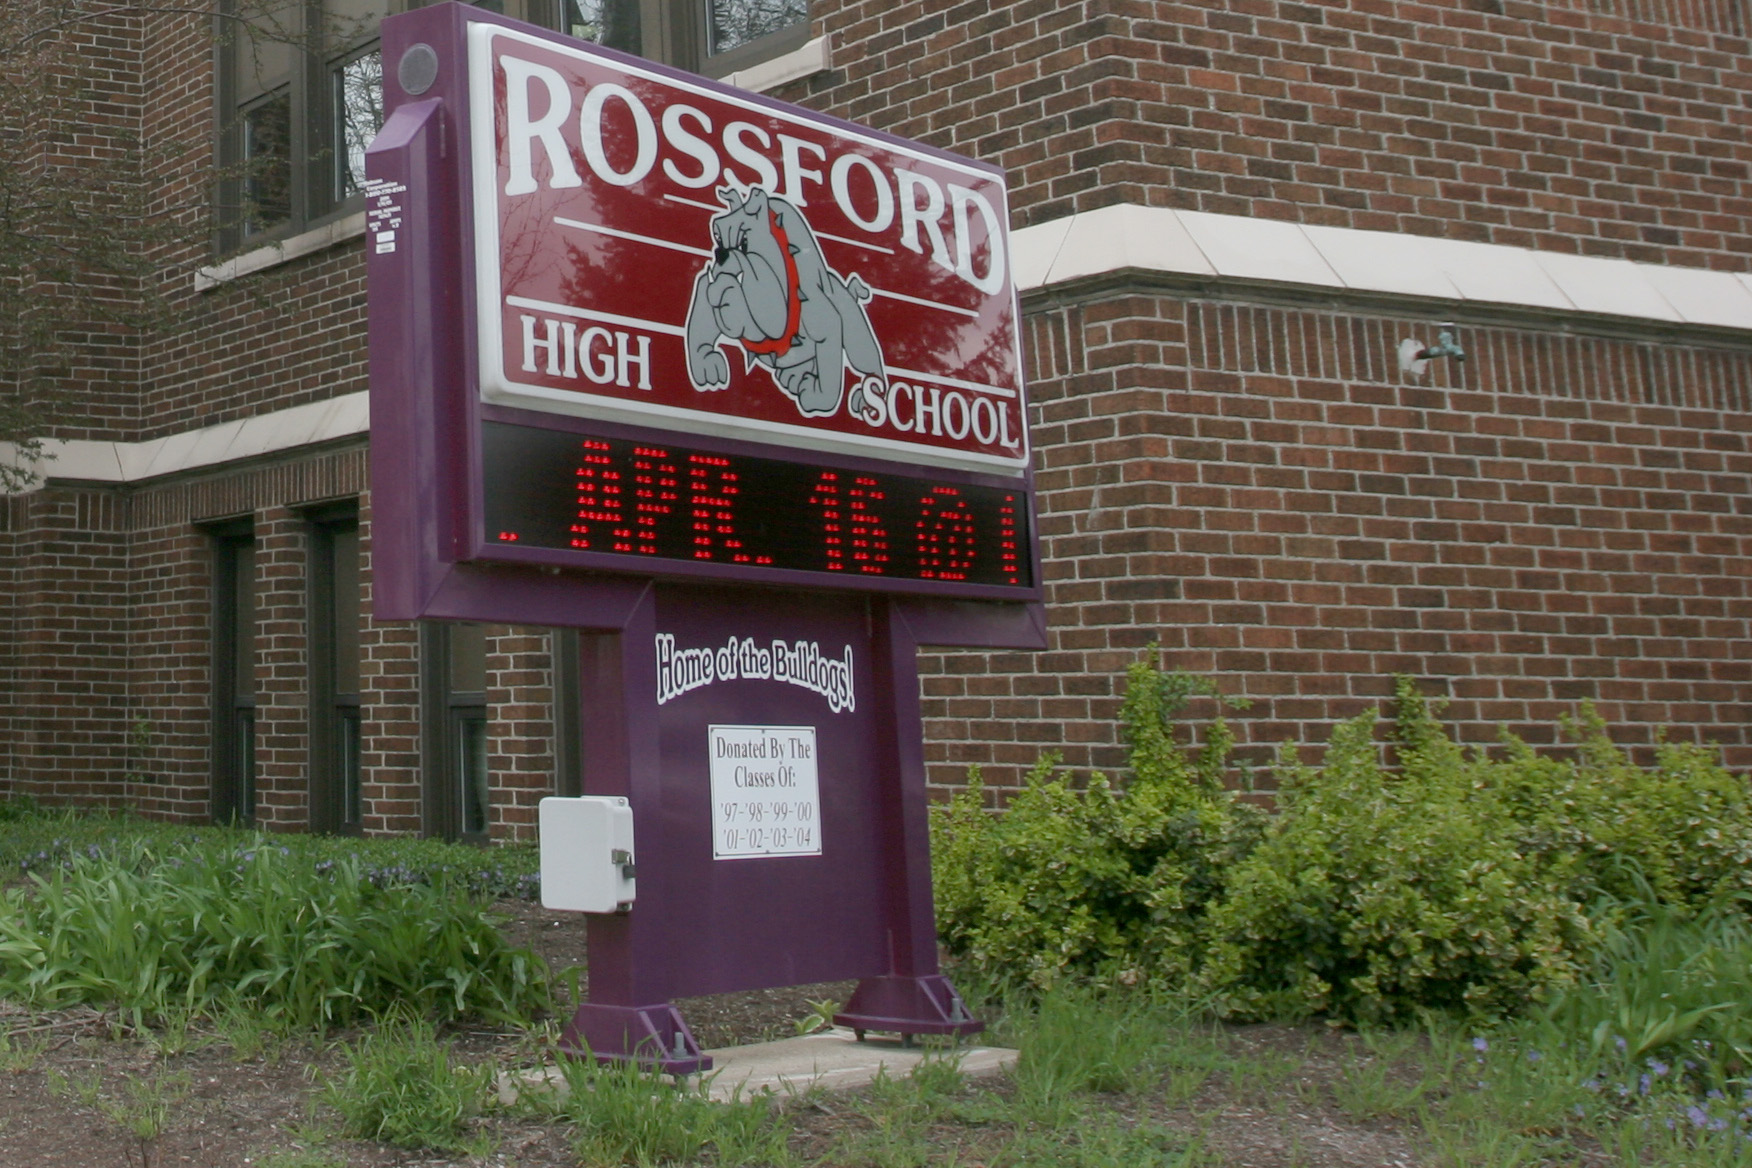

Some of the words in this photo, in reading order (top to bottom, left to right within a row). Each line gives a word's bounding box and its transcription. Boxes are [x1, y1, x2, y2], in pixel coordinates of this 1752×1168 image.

[500, 54, 1004, 295] ROSSFORD
[520, 315, 652, 391] HIGH
[861, 375, 1019, 449] SCHOOL
[570, 440, 772, 565] APR.
[808, 472, 889, 573] 16
[655, 633, 715, 705] Home
[716, 636, 738, 681] of
[739, 637, 771, 680] the
[772, 640, 856, 714] Bulldogs!
[716, 736, 766, 759] Donated
[770, 737, 785, 764] By
[788, 737, 811, 759] The
[734, 765, 775, 788] Classes
[778, 765, 796, 788] Of:
